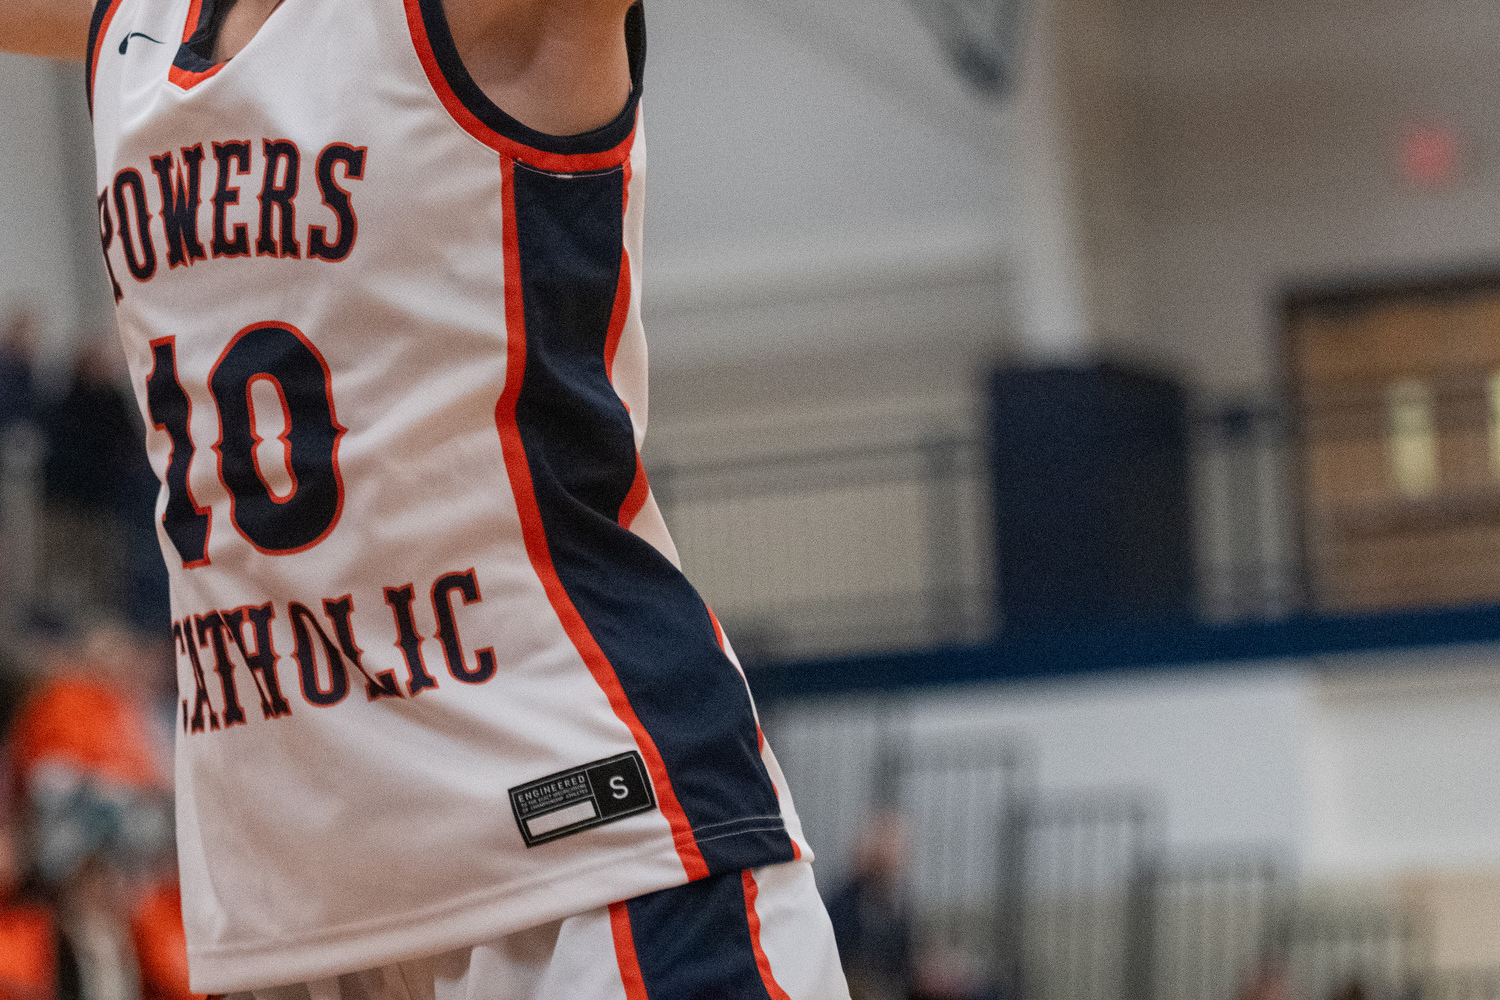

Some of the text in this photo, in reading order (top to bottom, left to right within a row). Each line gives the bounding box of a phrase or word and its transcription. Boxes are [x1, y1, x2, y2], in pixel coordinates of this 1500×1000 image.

[97, 138, 368, 307] POWERS
[146, 320, 348, 570] 10
[517, 775, 585, 803] ENGINEERED
[609, 776, 630, 800] S
